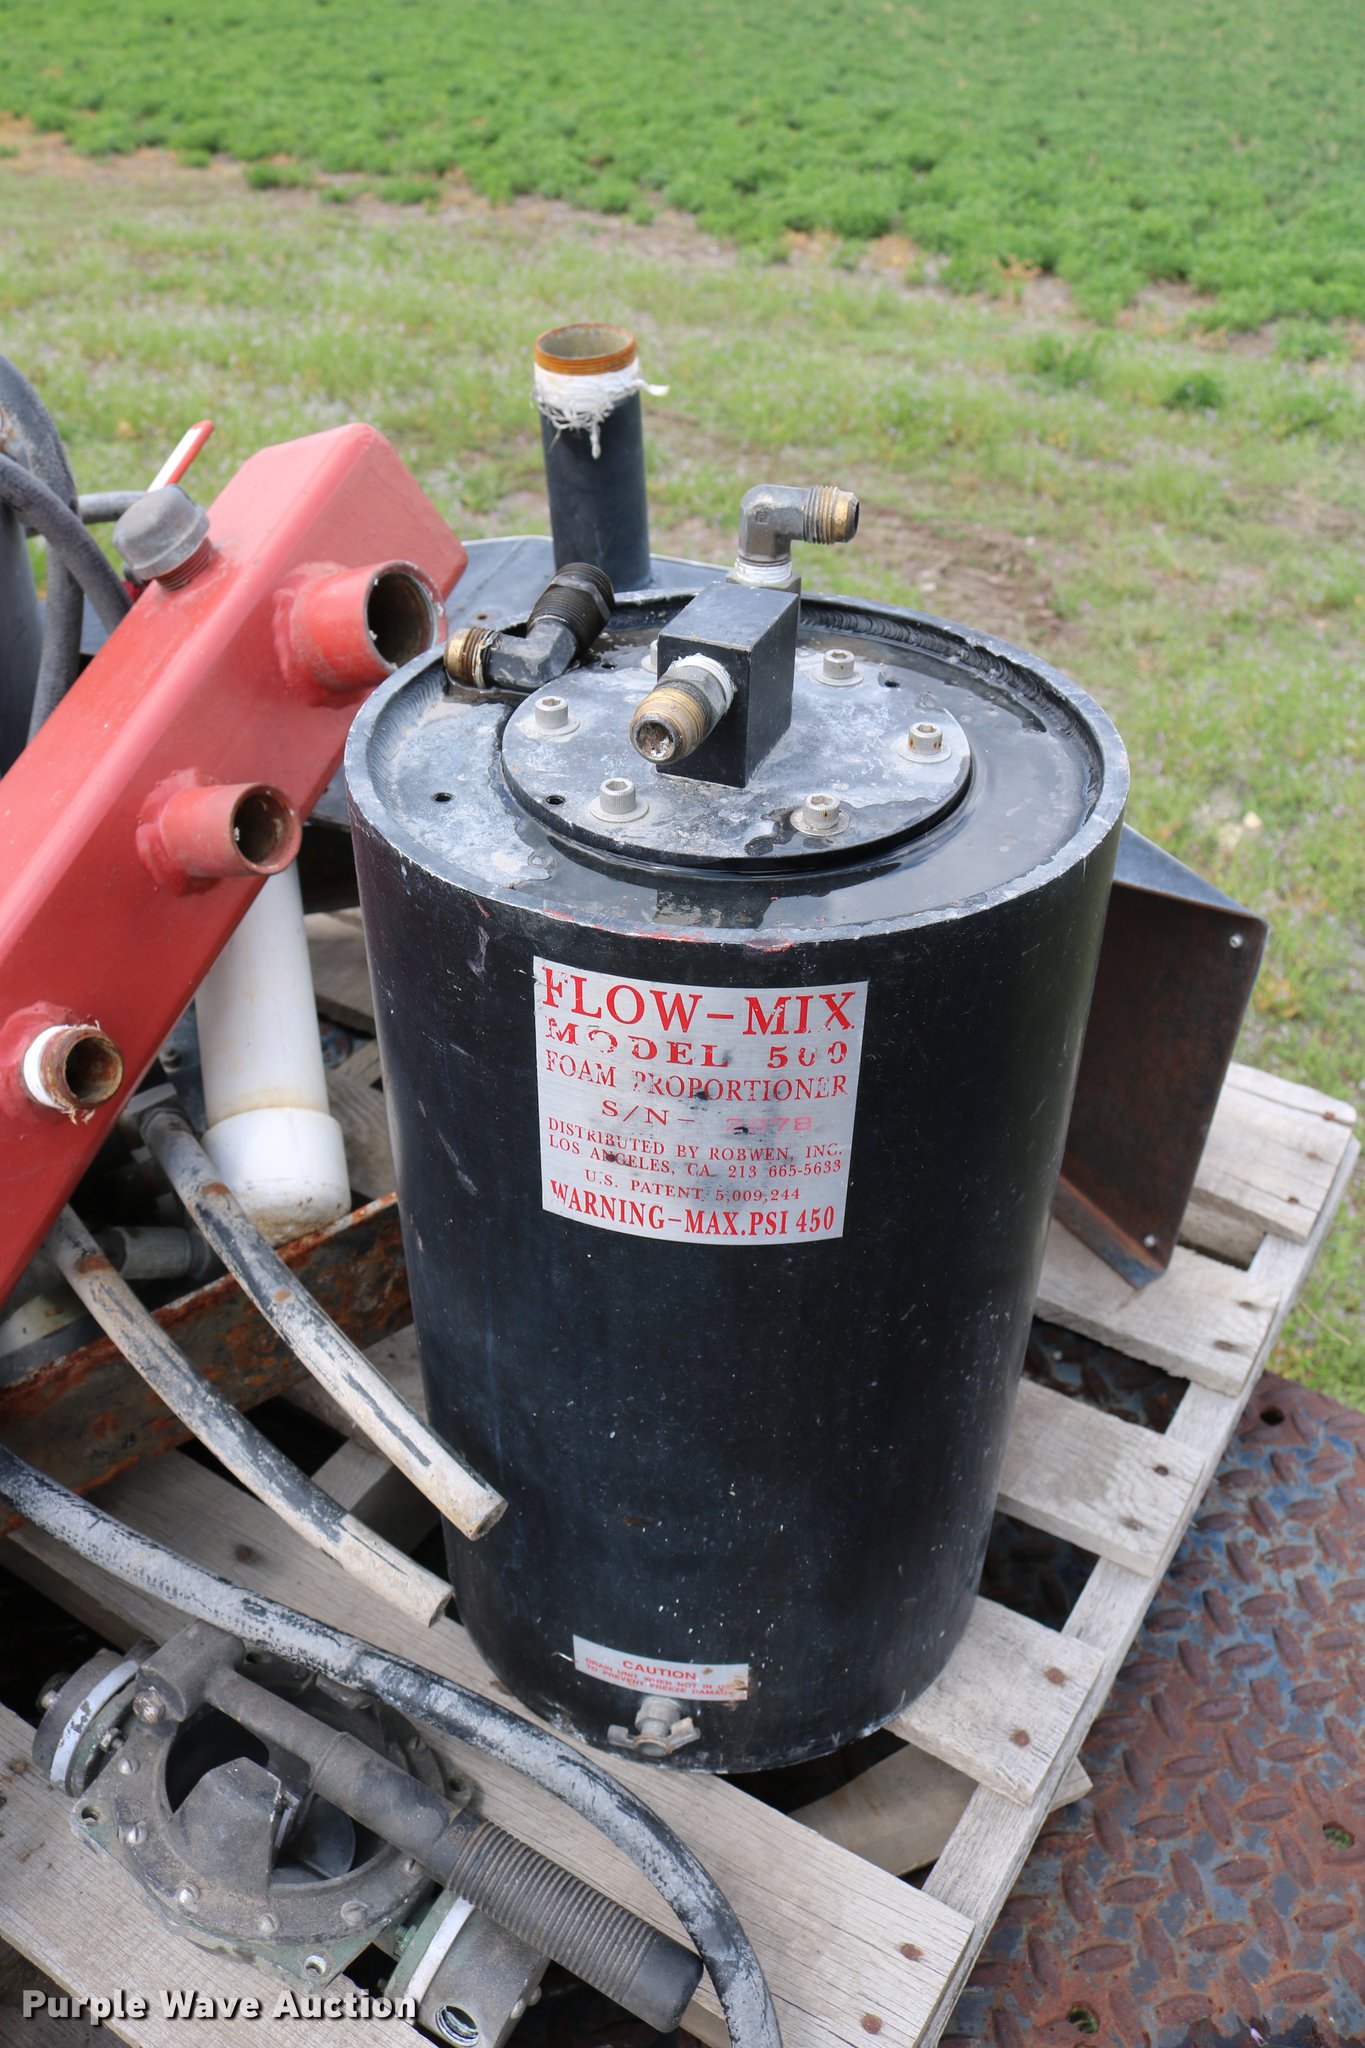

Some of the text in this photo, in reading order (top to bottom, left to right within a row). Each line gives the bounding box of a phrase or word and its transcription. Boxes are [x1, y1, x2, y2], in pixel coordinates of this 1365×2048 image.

[545, 1016, 848, 1069] MODEL 500
[545, 1049, 848, 1102] FOAM PROPORTIONER
[548, 1116, 842, 1162] DISTRIBUTED BY ROBWEN, INC.
[549, 1133, 580, 1155] LOS
[590, 1147, 675, 1176] ANGELES,
[728, 1164, 757, 1178] 213
[769, 1159, 841, 1178] 665-5633
[585, 1168, 800, 1204] U.S. PATENT 5,009,244
[796, 1205, 835, 1234] 450
[622, 1660, 697, 1680] CAUTION
